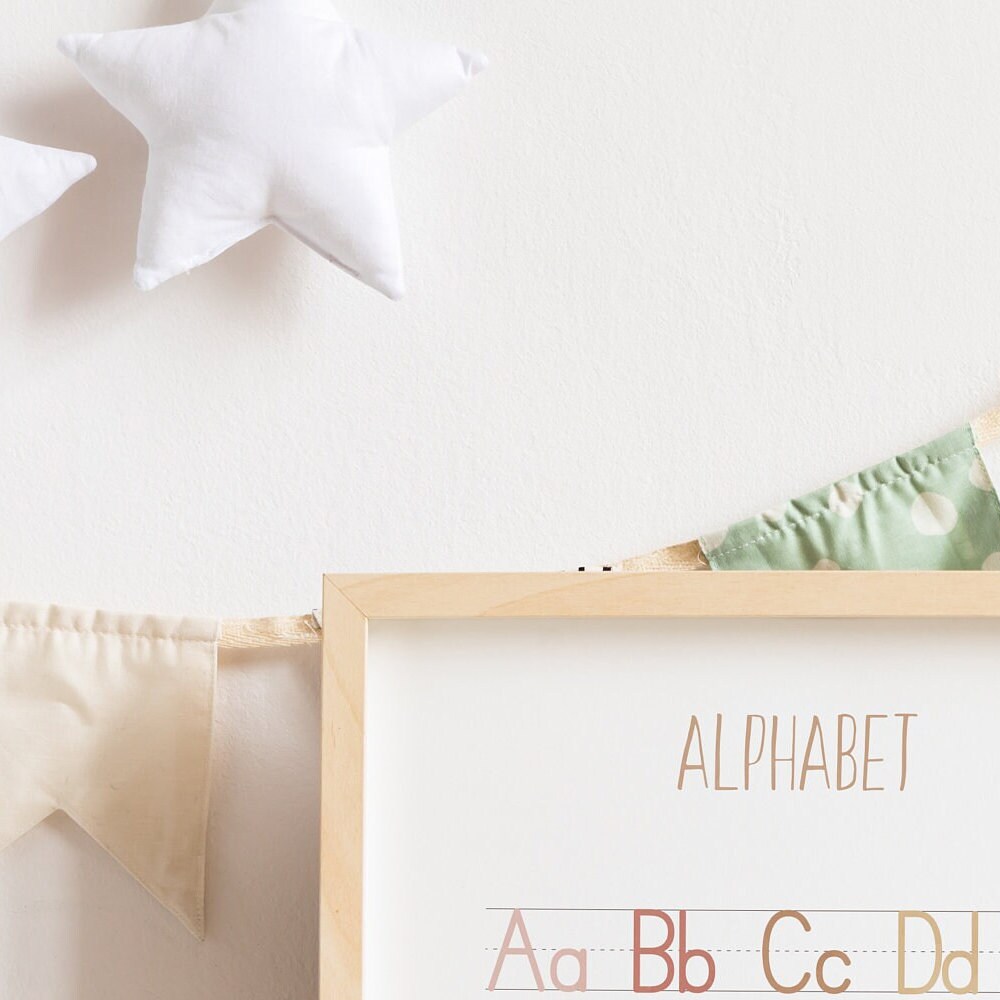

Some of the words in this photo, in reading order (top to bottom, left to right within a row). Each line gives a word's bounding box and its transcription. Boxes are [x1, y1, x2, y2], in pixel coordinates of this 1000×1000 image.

[677, 713, 918, 791] ALPHABET
[488, 908, 587, 992] Aa
[633, 909, 715, 993] Bb
[762, 909, 851, 994] Cc
[898, 910, 979, 995] Dd
